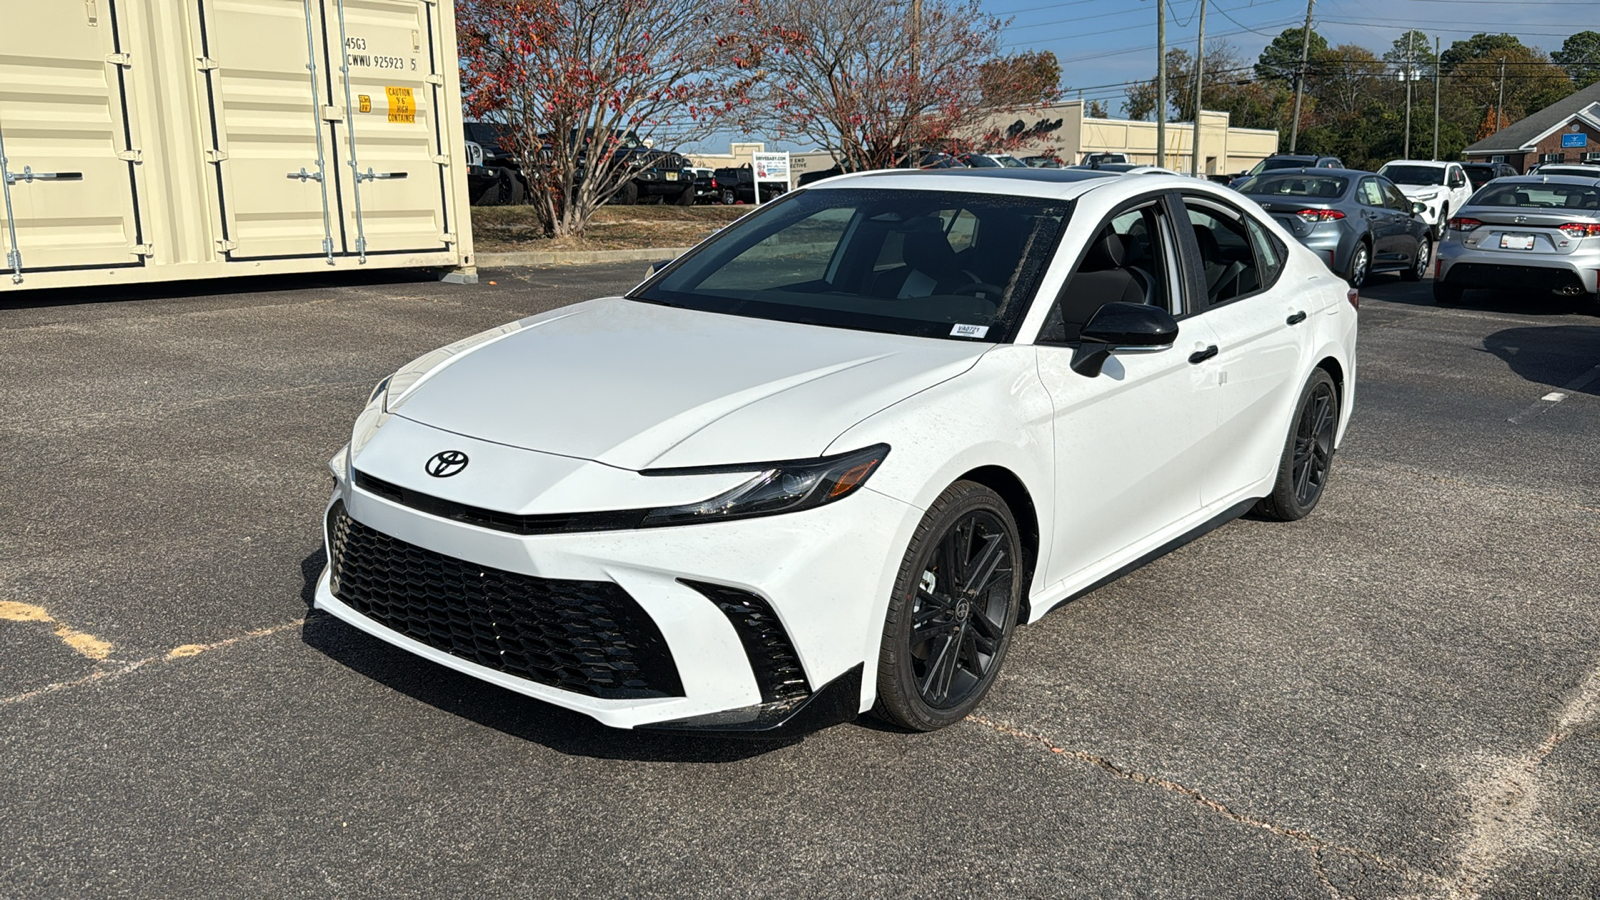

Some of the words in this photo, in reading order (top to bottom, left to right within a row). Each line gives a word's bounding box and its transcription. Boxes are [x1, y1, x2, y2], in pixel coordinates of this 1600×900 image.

[345, 37, 366, 50] 45G3
[347, 54, 371, 67] CWWU
[373, 56, 404, 70] 925923
[410, 58, 417, 71] 5
[388, 88, 410, 96] CAUTION
[396, 106, 408, 114] HIGH
[388, 114, 415, 123] CONTAINER
